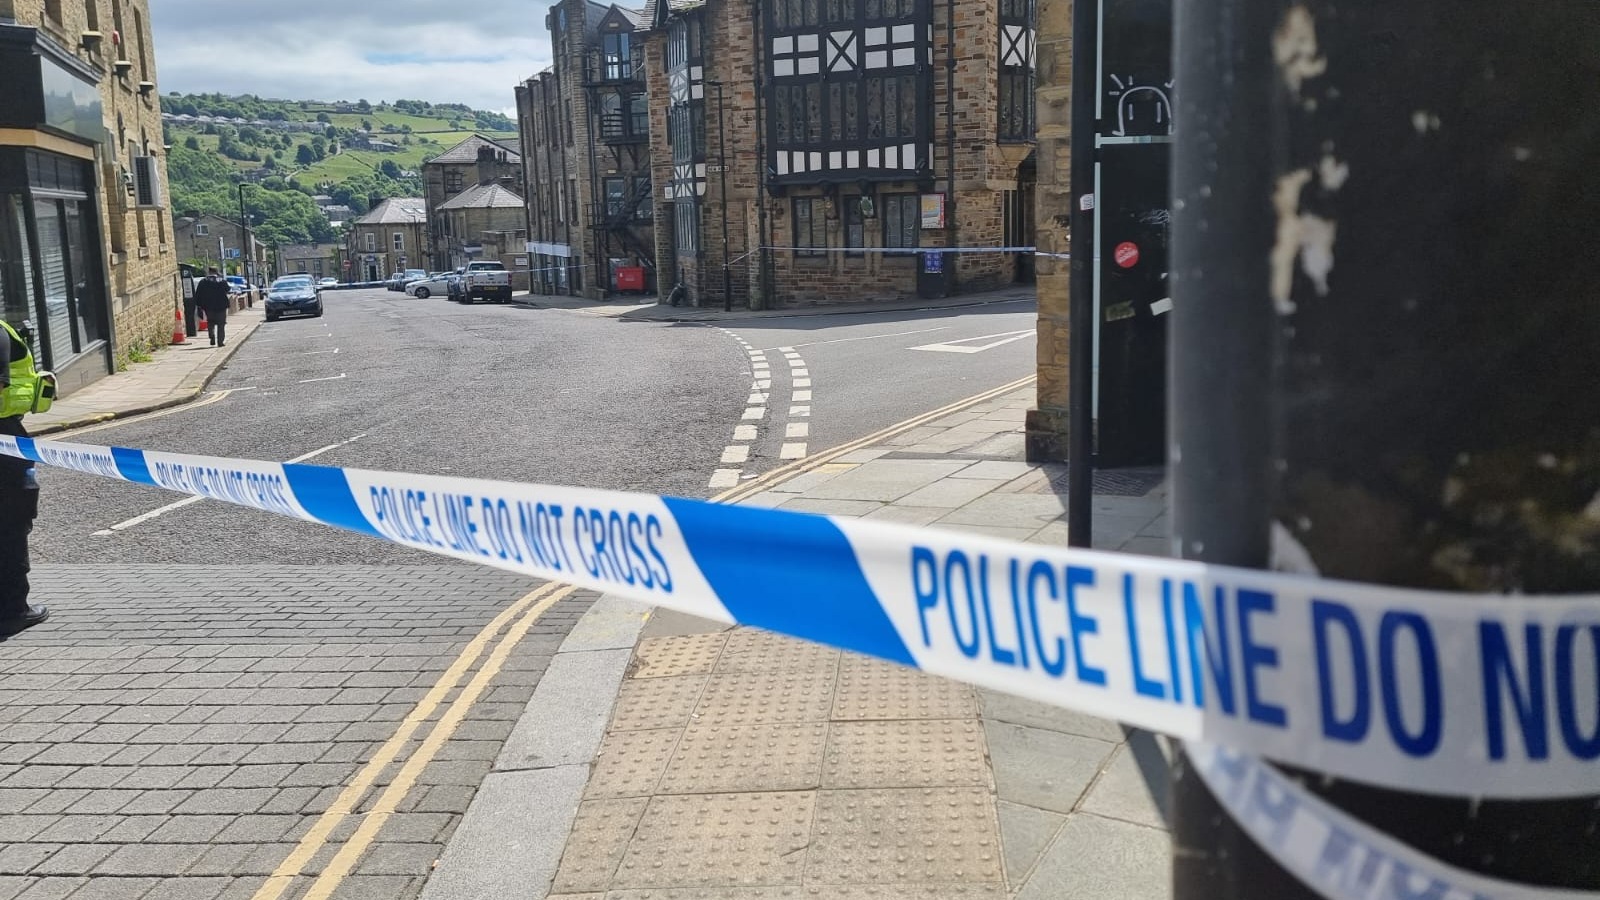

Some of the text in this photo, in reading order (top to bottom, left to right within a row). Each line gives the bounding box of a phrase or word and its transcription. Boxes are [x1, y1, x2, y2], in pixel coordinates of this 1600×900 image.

[370, 485, 673, 593] POLICE LINE DO NOT CROSS
[911, 545, 1107, 687] POLICE
[1122, 572, 1287, 729] LINE
[1311, 599, 1444, 758] DO
